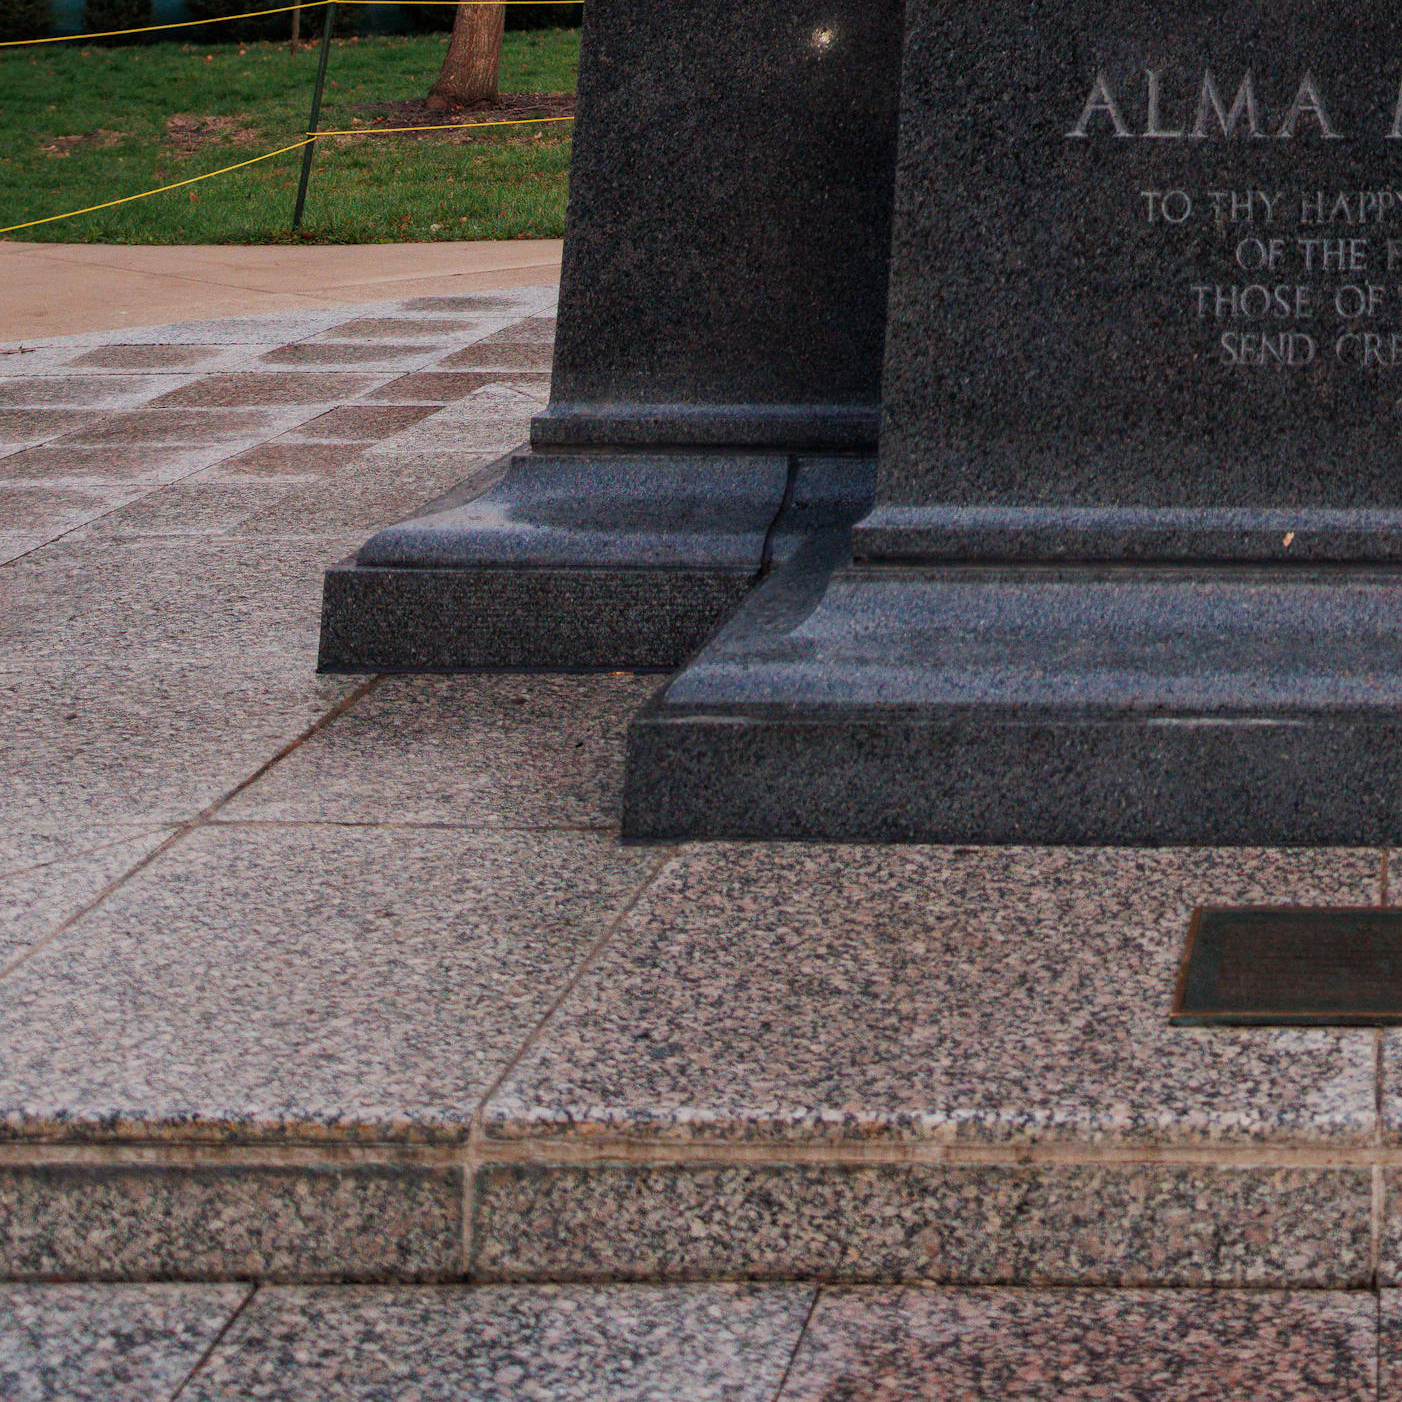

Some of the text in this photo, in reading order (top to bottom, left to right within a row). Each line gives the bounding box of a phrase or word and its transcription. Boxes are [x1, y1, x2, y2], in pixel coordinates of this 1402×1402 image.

[1064, 68, 1345, 139] ALMA
[1140, 190, 1192, 223] TO
[1207, 191, 1283, 223] THY
[1235, 237, 1286, 271] OF
[1298, 238, 1368, 271] THE
[1190, 284, 1314, 318] THOSE
[1334, 284, 1385, 318] OF
[1219, 332, 1315, 365] SEND
